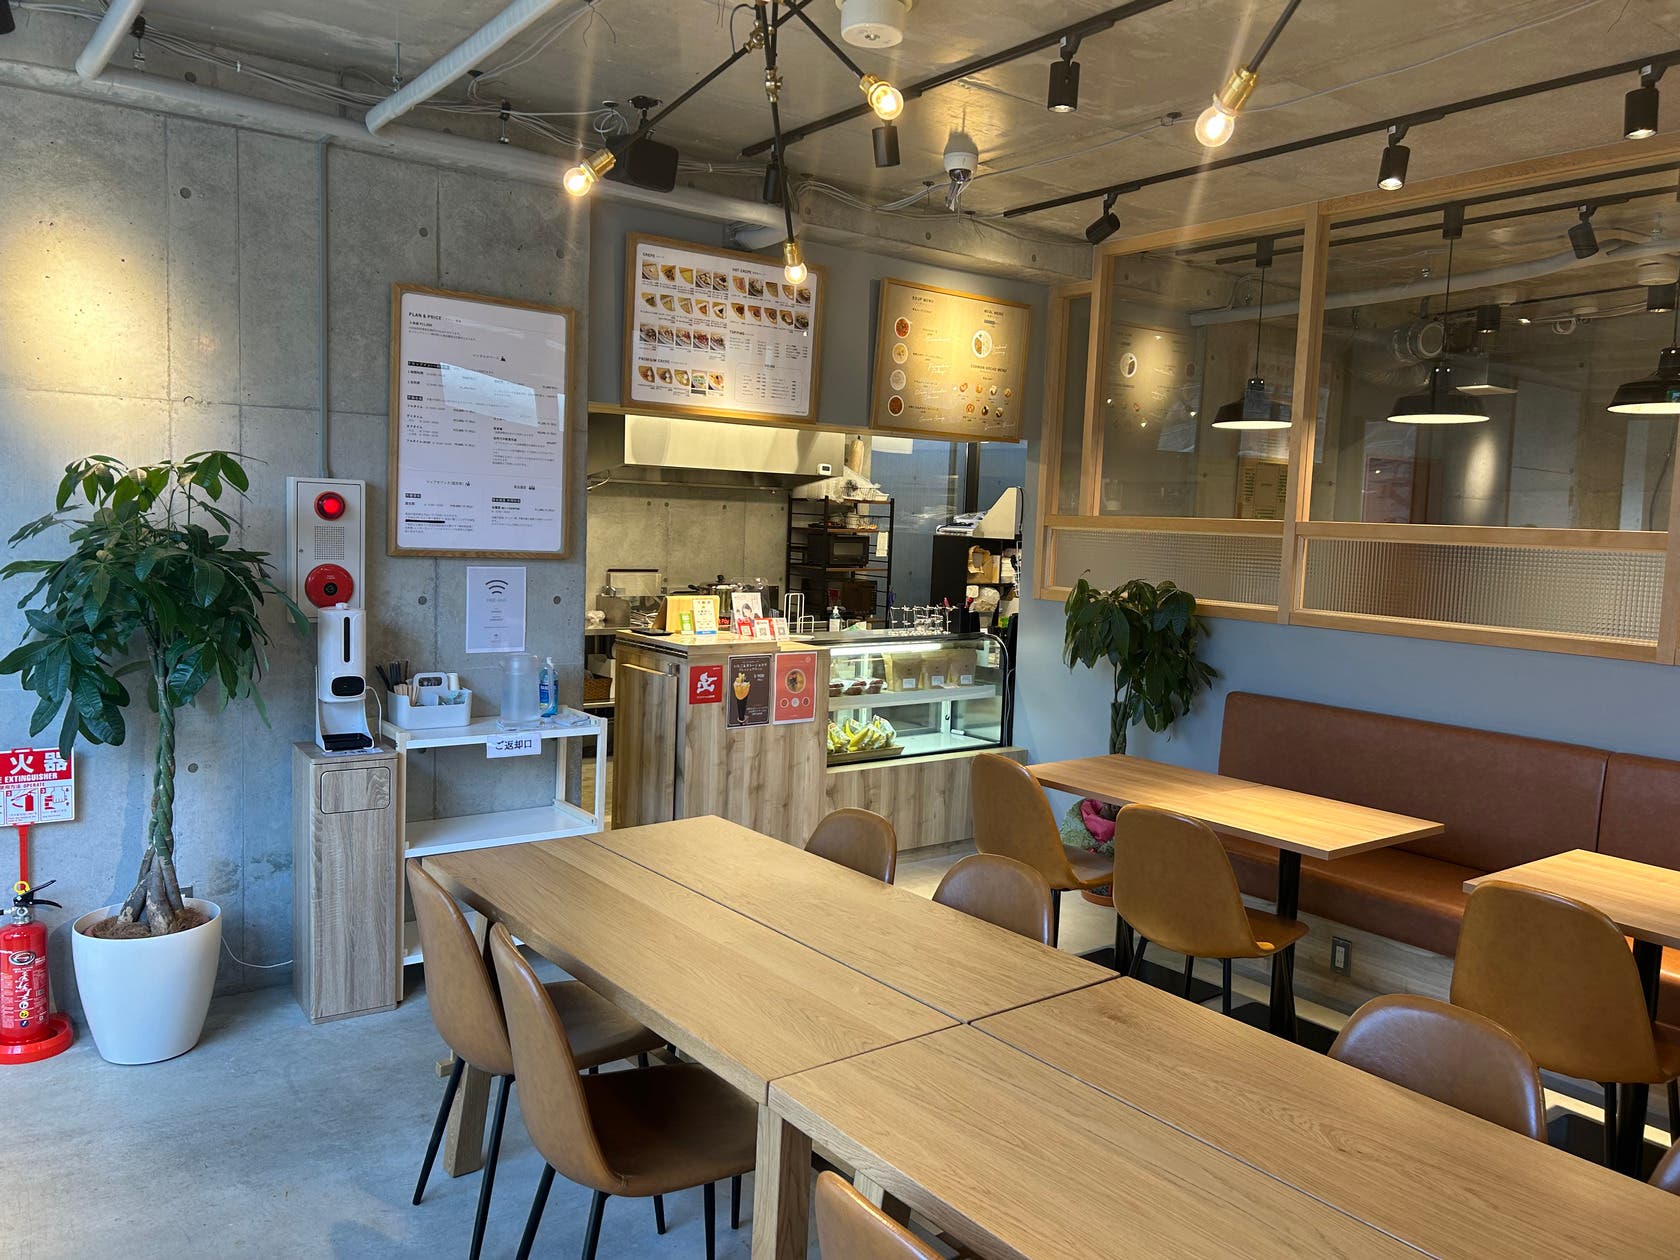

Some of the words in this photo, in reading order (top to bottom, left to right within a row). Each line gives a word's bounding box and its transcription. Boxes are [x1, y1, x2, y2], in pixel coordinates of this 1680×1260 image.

[495, 739, 532, 750] ご返却口
[4, 772, 58, 784] EXTINGUISHER
